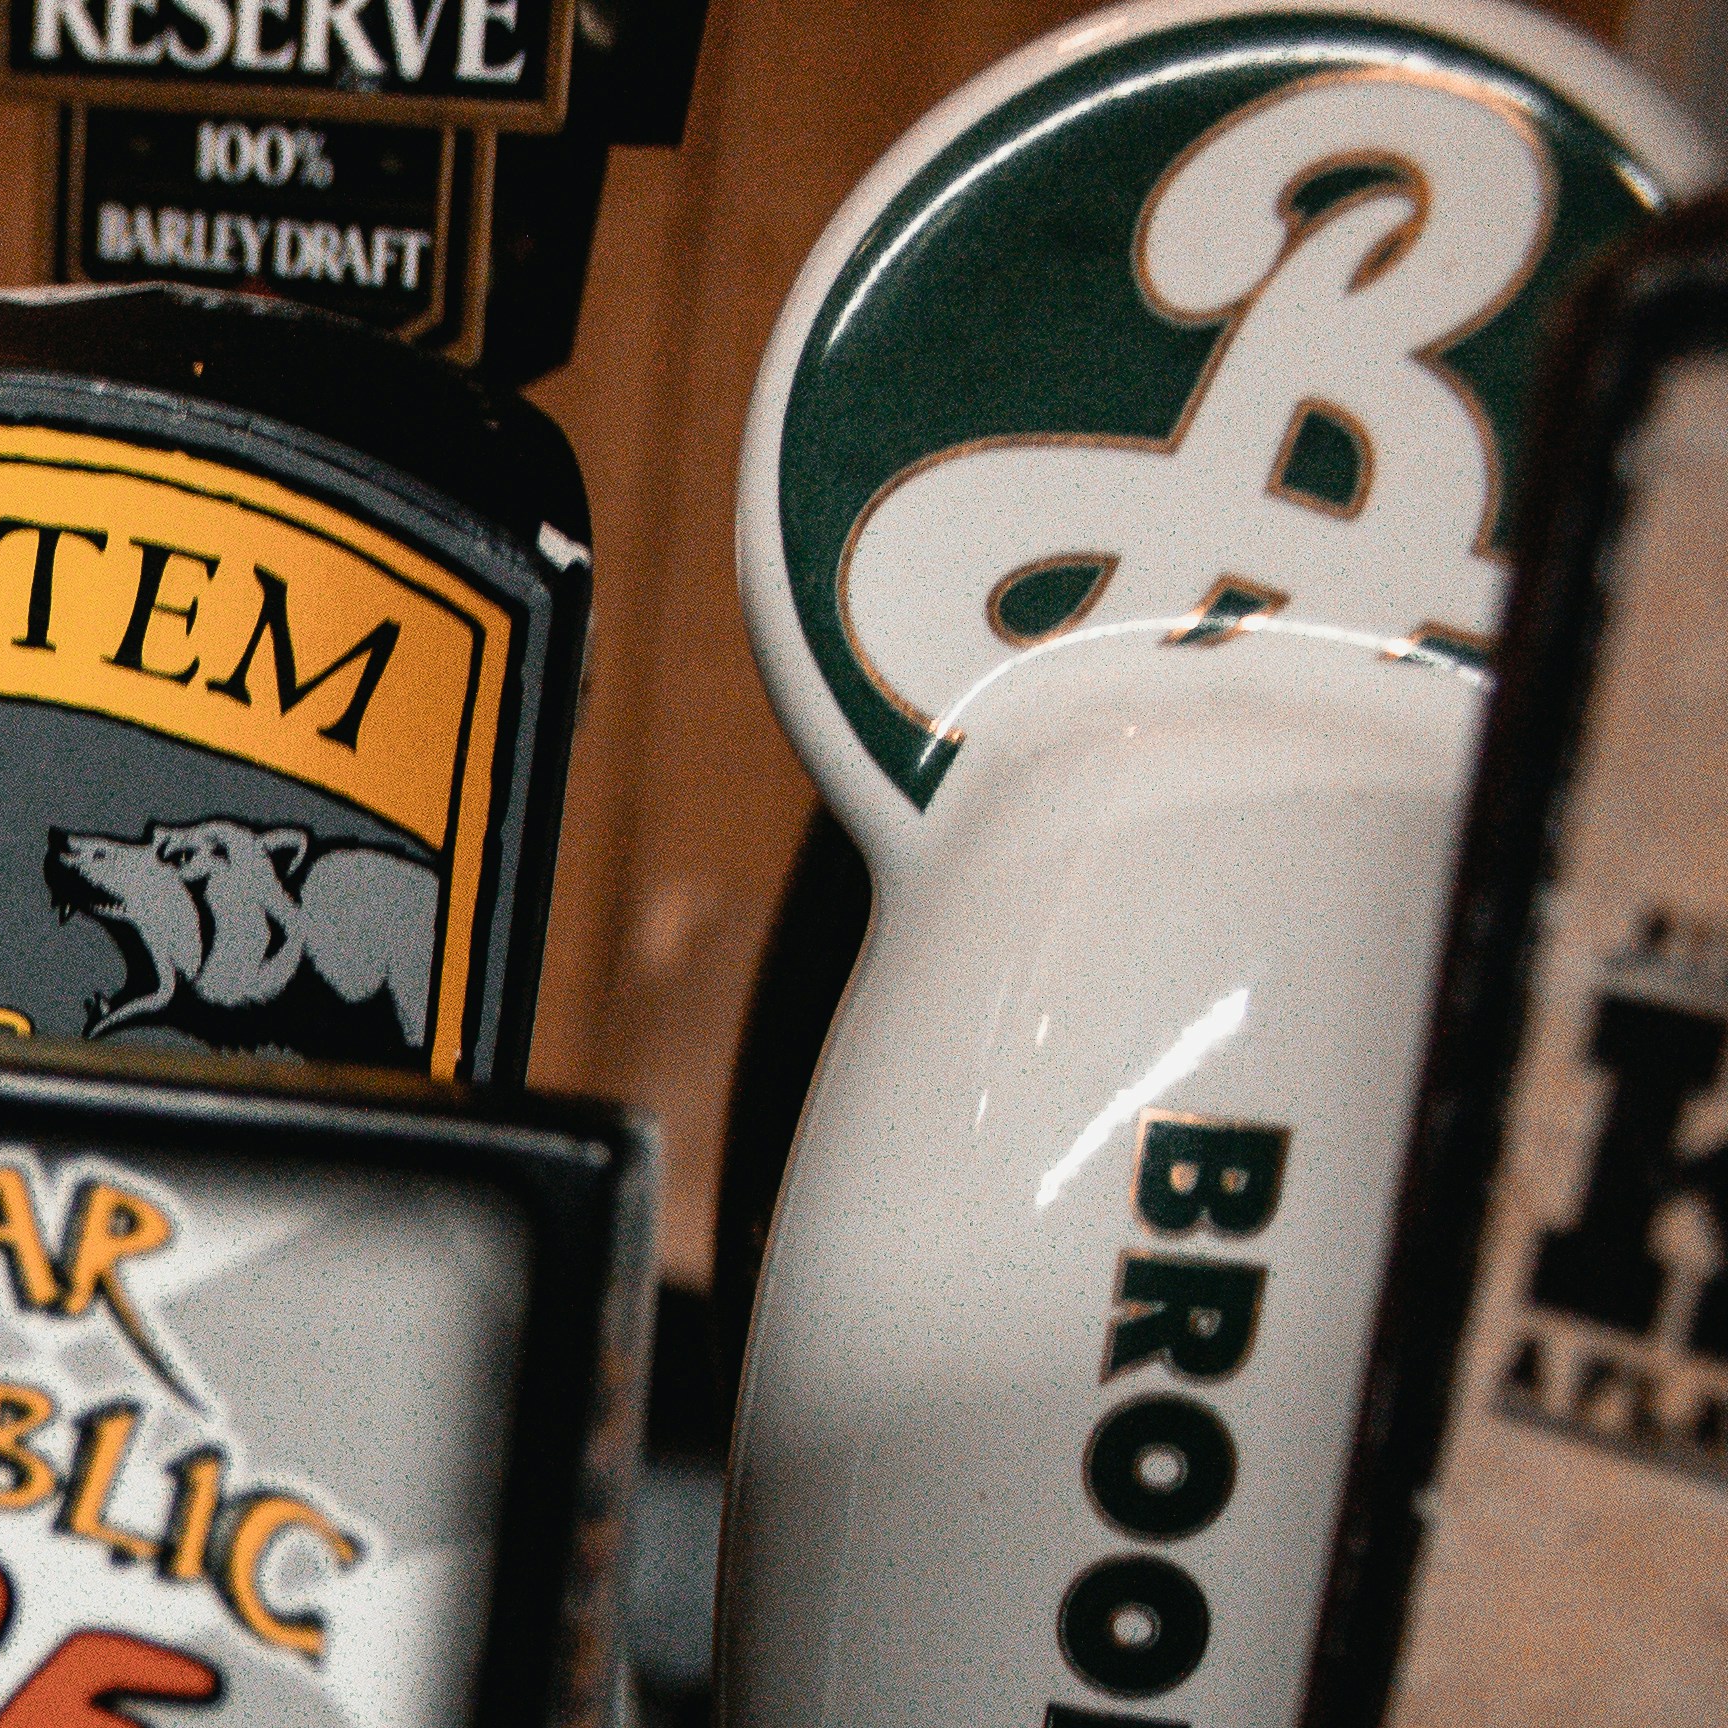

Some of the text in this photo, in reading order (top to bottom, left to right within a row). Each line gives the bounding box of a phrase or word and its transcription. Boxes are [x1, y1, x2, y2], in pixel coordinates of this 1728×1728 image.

[28, 0, 526, 83] RESERVE
[194, 122, 336, 189] 100%
[95, 202, 432, 292] BARLEY DRAFT
